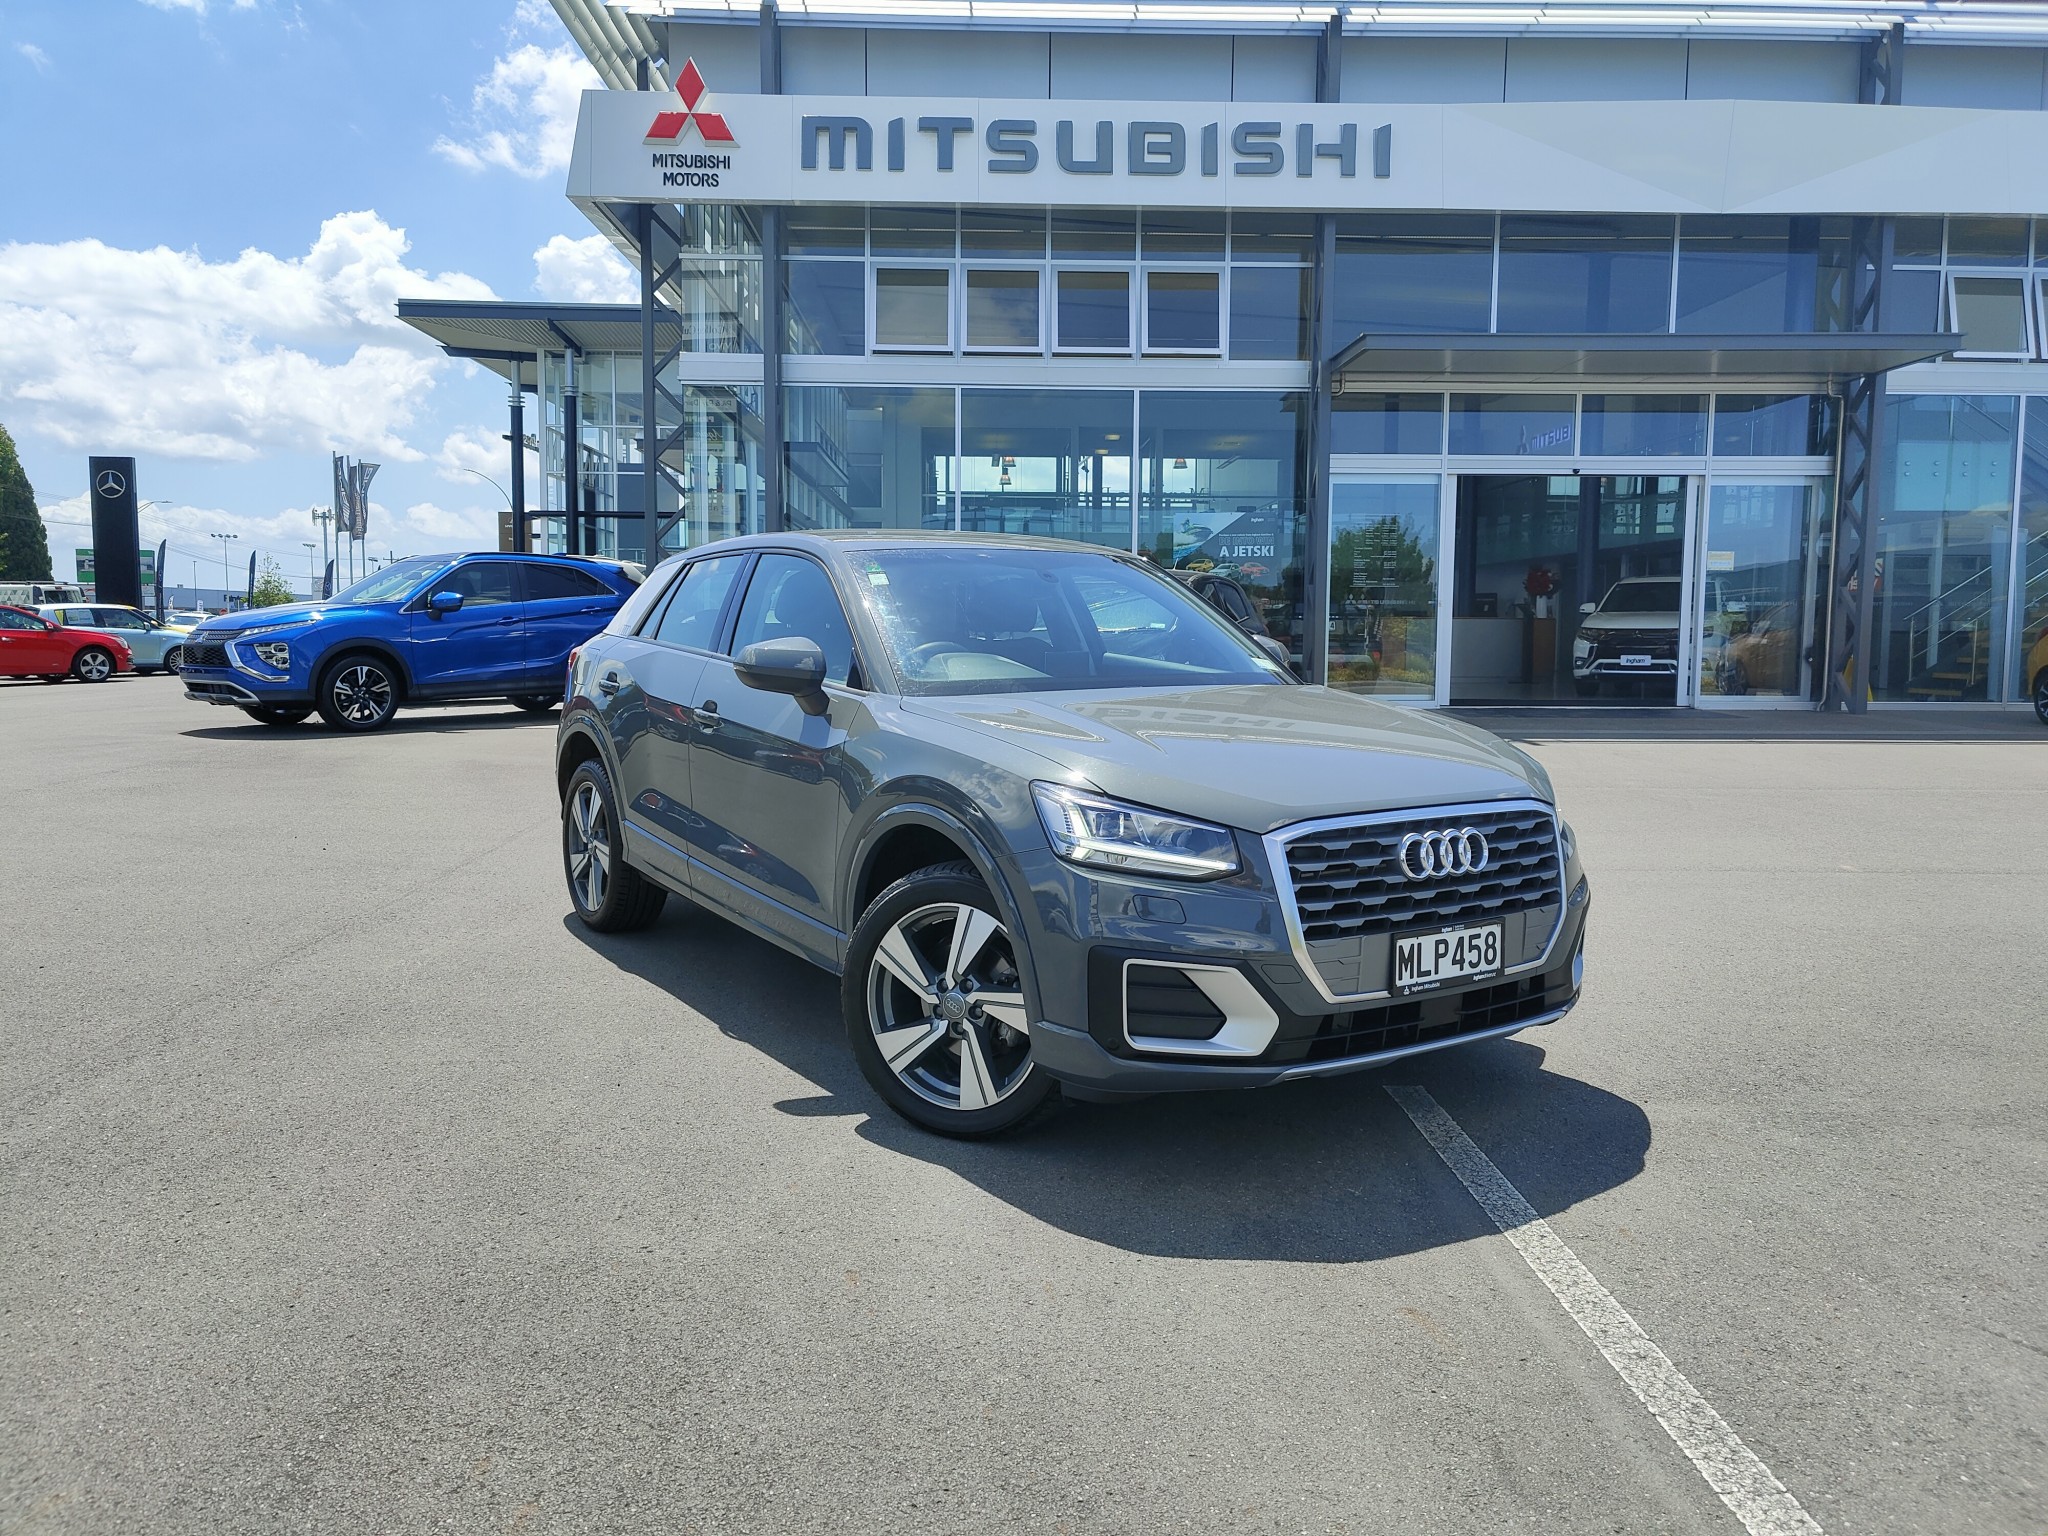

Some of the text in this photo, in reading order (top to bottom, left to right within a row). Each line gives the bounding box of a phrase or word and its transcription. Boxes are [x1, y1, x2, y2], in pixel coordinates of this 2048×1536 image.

[801, 115, 1391, 178] MITSUBISHI
[652, 153, 731, 170] MITSUBISHI
[662, 171, 720, 188] MOTORS
[1219, 545, 1275, 557] A JETSKI
[1398, 931, 1498, 982] MLP458
